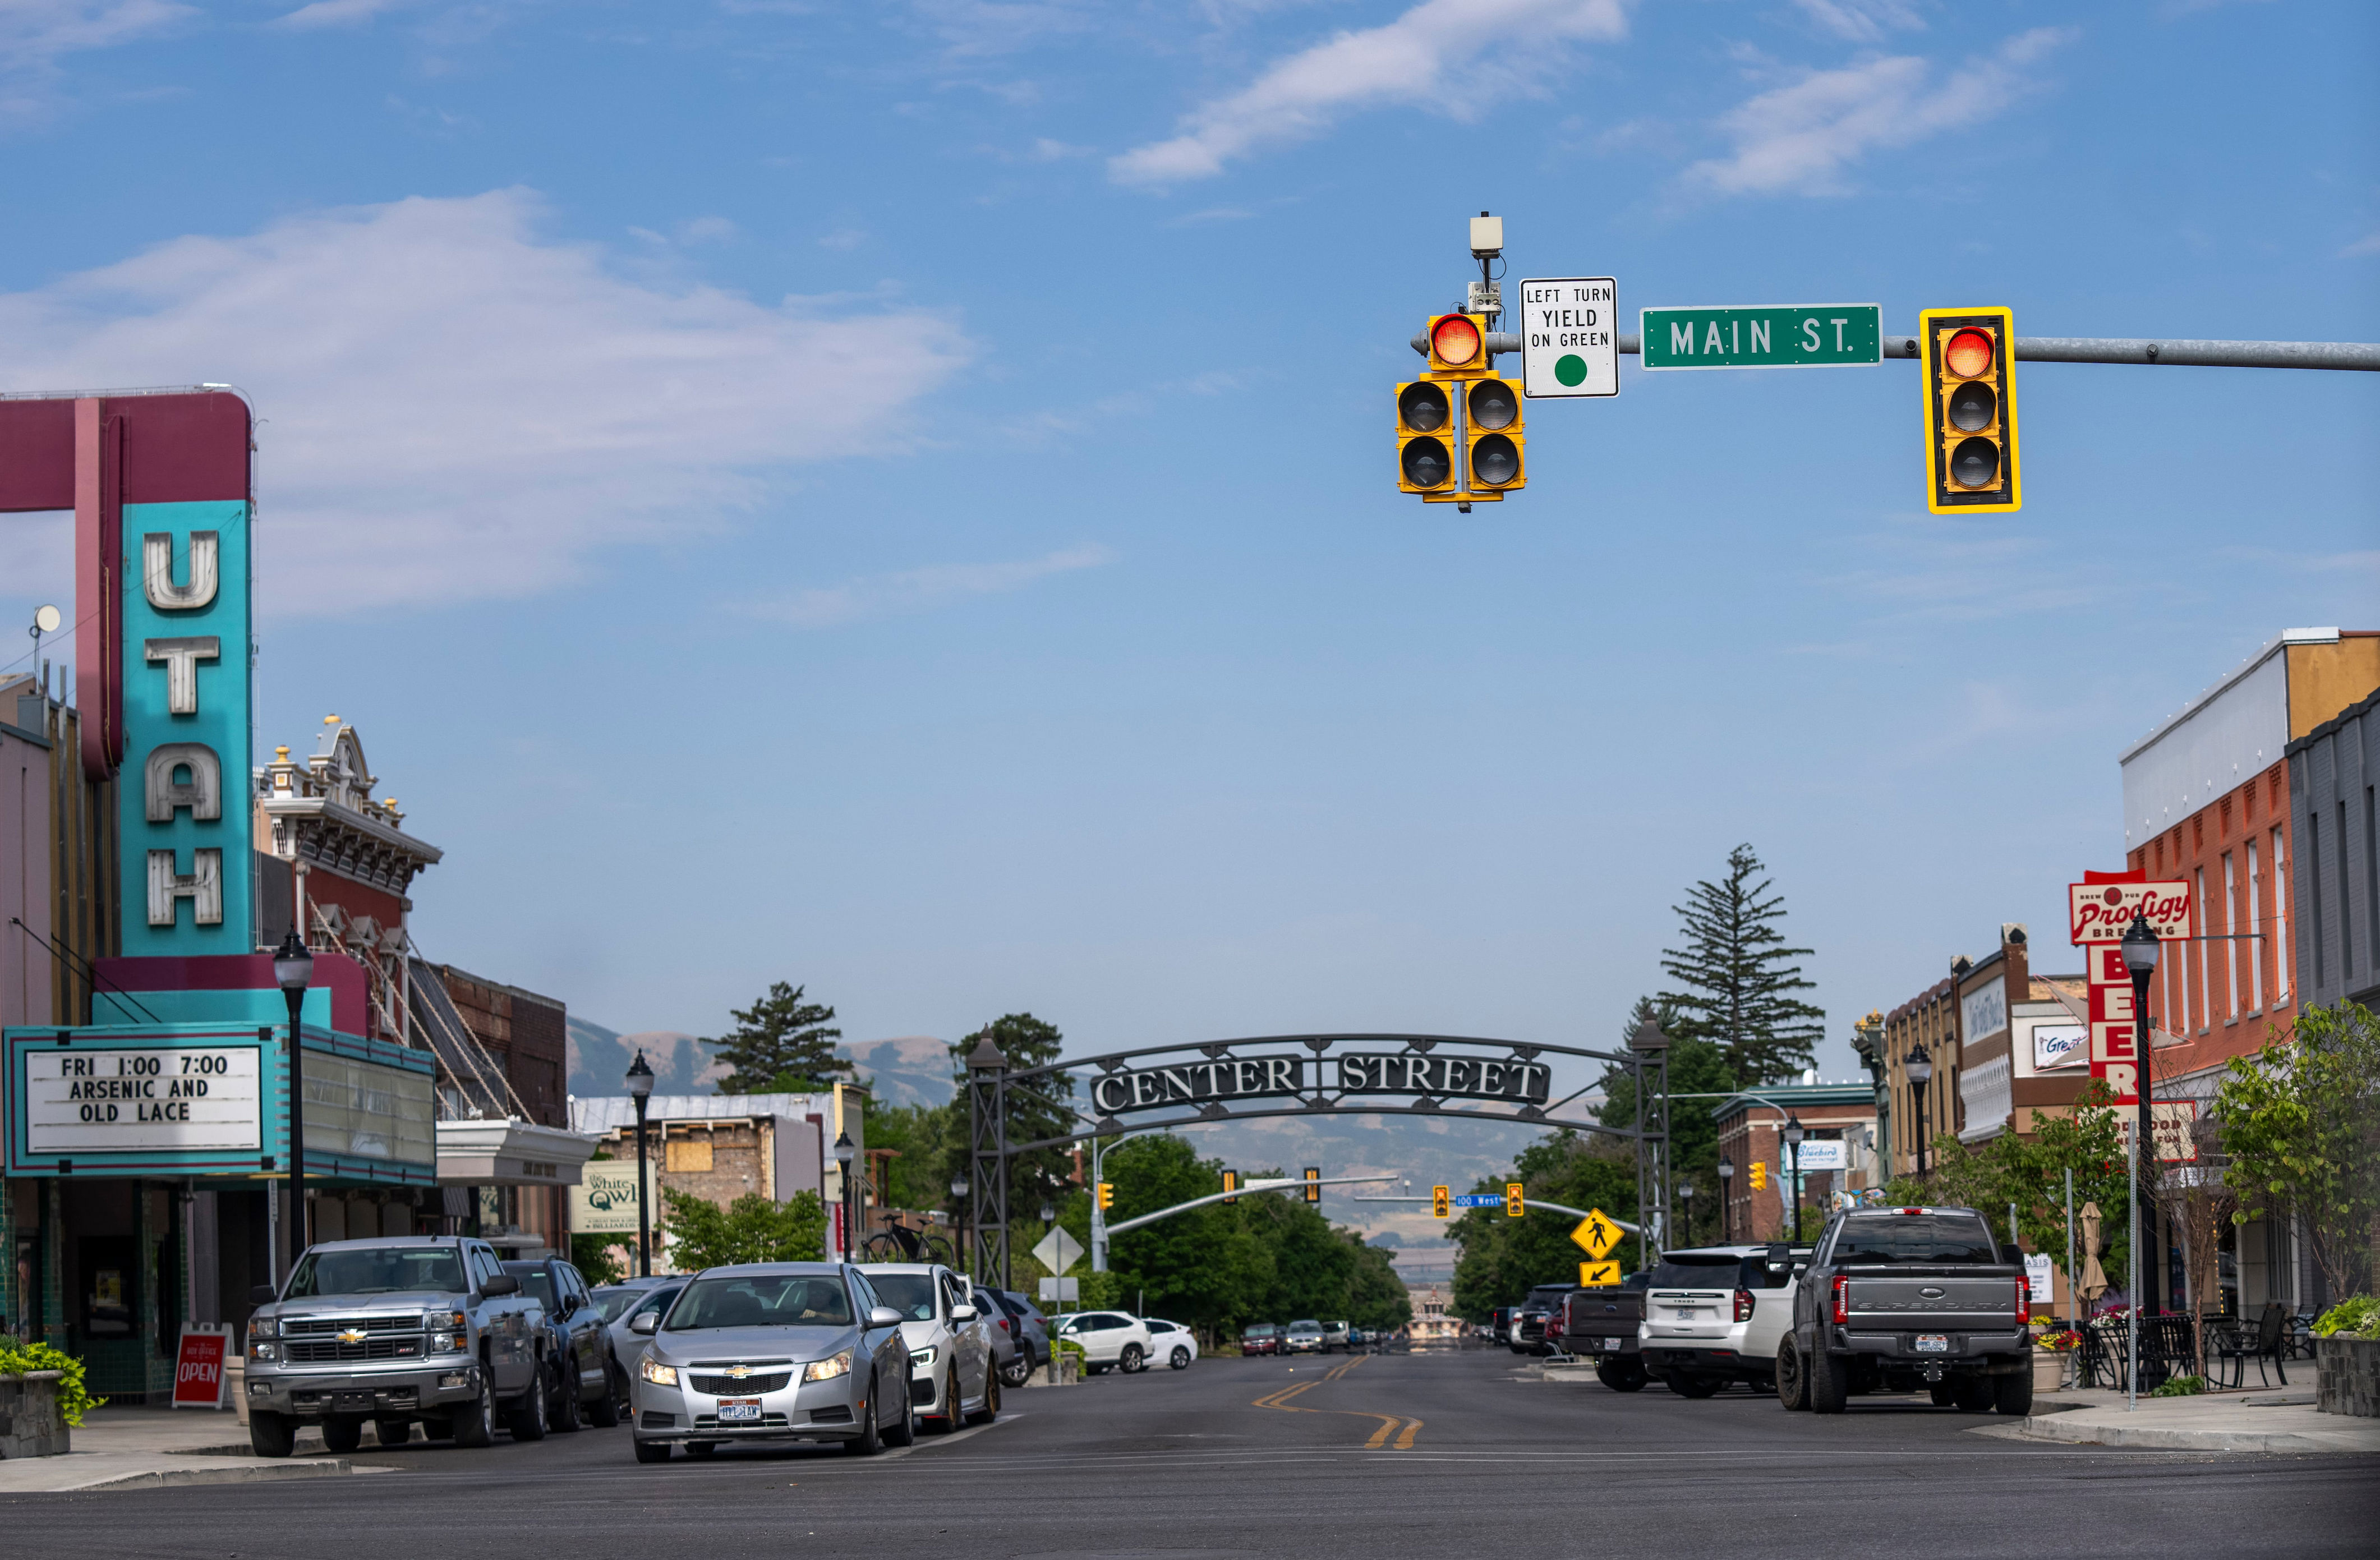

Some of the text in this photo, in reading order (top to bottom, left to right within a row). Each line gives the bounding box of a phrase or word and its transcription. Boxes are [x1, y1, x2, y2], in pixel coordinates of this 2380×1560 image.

[1527, 288, 1610, 303] LEFT TURN
[1543, 310, 1596, 327] YIELD
[1532, 333, 1608, 347] ON GREEN
[1671, 317, 1853, 355] MAIN ST.
[142, 530, 223, 925] UTAH
[2074, 891, 2189, 939] Prodigy
[2093, 926, 2175, 937] BRENG
[2103, 950, 2138, 1096] BEER
[62, 1056, 228, 1075] FRI 1:00 7:00
[70, 1079, 208, 1099] ARSENIC AND
[1095, 1056, 1542, 1111] CENTER STREET
[80, 1102, 190, 1122] OLD LACE
[2151, 1120, 2181, 1131] OOD
[1458, 1196, 1498, 1205] 100 West
[180, 1362, 218, 1384] OPEN
